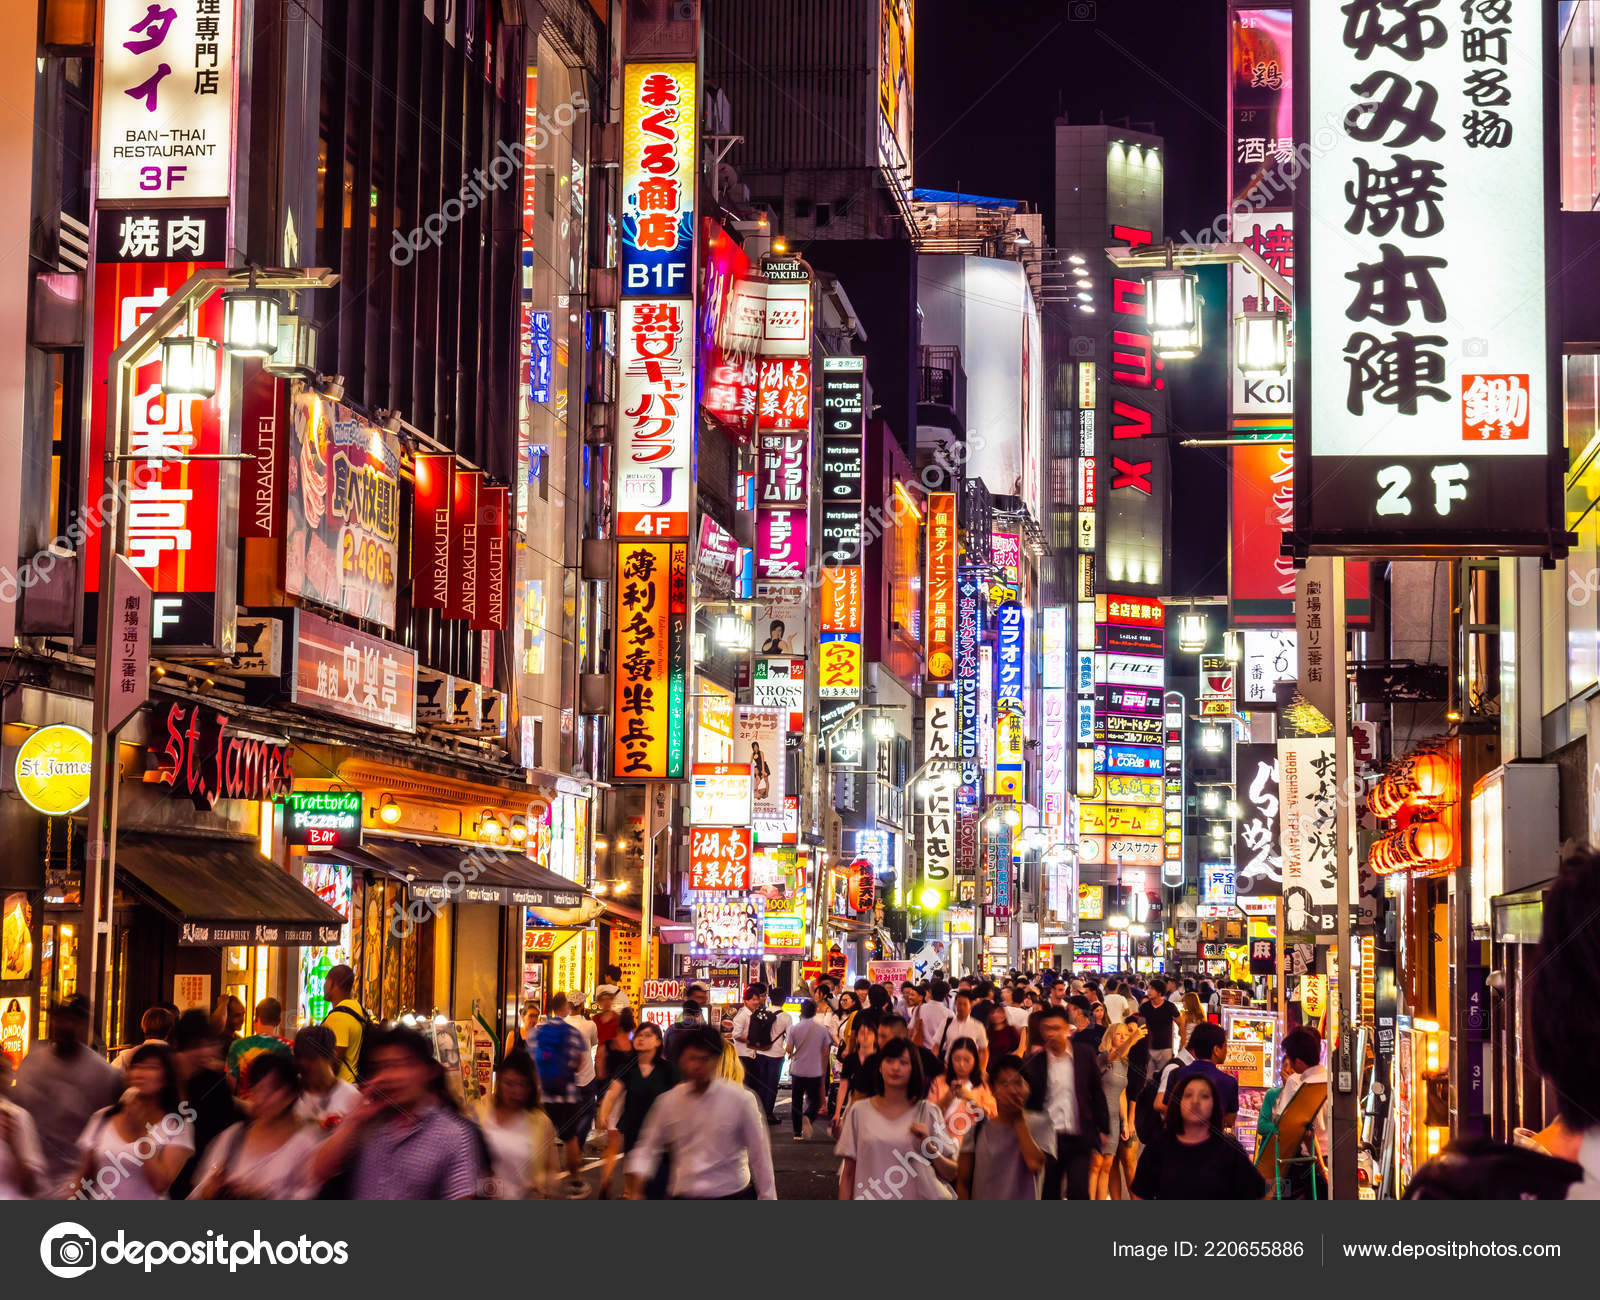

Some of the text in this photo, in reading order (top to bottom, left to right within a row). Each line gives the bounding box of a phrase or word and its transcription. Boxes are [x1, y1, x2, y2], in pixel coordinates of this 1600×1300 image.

[1241, 18, 1257, 29] 2F
[122, 3, 178, 112] タイ
[1240, 111, 1257, 122] 2F
[113, 144, 216, 158] RESTAURANT
[126, 129, 206, 142] BAN-THAI
[1237, 137, 1294, 164] 酒場
[139, 165, 188, 191] 3F
[638, 74, 680, 250] まぐろ商店
[119, 215, 206, 258] 焼肉
[627, 263, 686, 288] B1F
[764, 437, 782, 447] 3F
[255, 416, 277, 530] ANRAKUTEI
[763, 453, 782, 500] ルーム
[784, 436, 803, 500] レンタル
[1376, 462, 1470, 516] 2F
[634, 514, 671, 535] 4F
[769, 511, 792, 560] エデン
[434, 508, 450, 603] ANRAKUTEI
[462, 523, 477, 615] ANRAKUTEI
[488, 537, 503, 626] ANRAKUTEI
[934, 512, 947, 642] 個室ダイニング居酒屋
[1109, 601, 1162, 620] 全店営業中
[121, 595, 142, 693] 劇場通り一番街
[959, 597, 976, 678] ホテルがライバル
[1000, 606, 1021, 687] カラオケ
[1306, 580, 1322, 682] 劇場通り一番街
[317, 641, 399, 717] 焼肉 安楽亭
[825, 643, 855, 686] らーめん
[1081, 656, 1092, 689] SEGA
[1250, 655, 1266, 700] 一番街
[756, 685, 802, 696] XROSS
[761, 696, 797, 707] CASA
[1000, 684, 1020, 697] 747
[1009, 715, 1021, 752] 麻雀
[1080, 705, 1091, 738] SEGA
[1046, 696, 1063, 785] カラオケ
[714, 765, 729, 774] 2F
[290, 793, 358, 811] Trattoria
[1286, 751, 1302, 879] HIROSHIMA TEPPANYAKI
[310, 829, 336, 843] Bar
[753, 821, 789, 832] CASA
[1109, 815, 1142, 830] ゲーム
[644, 980, 679, 1000] 19:00
